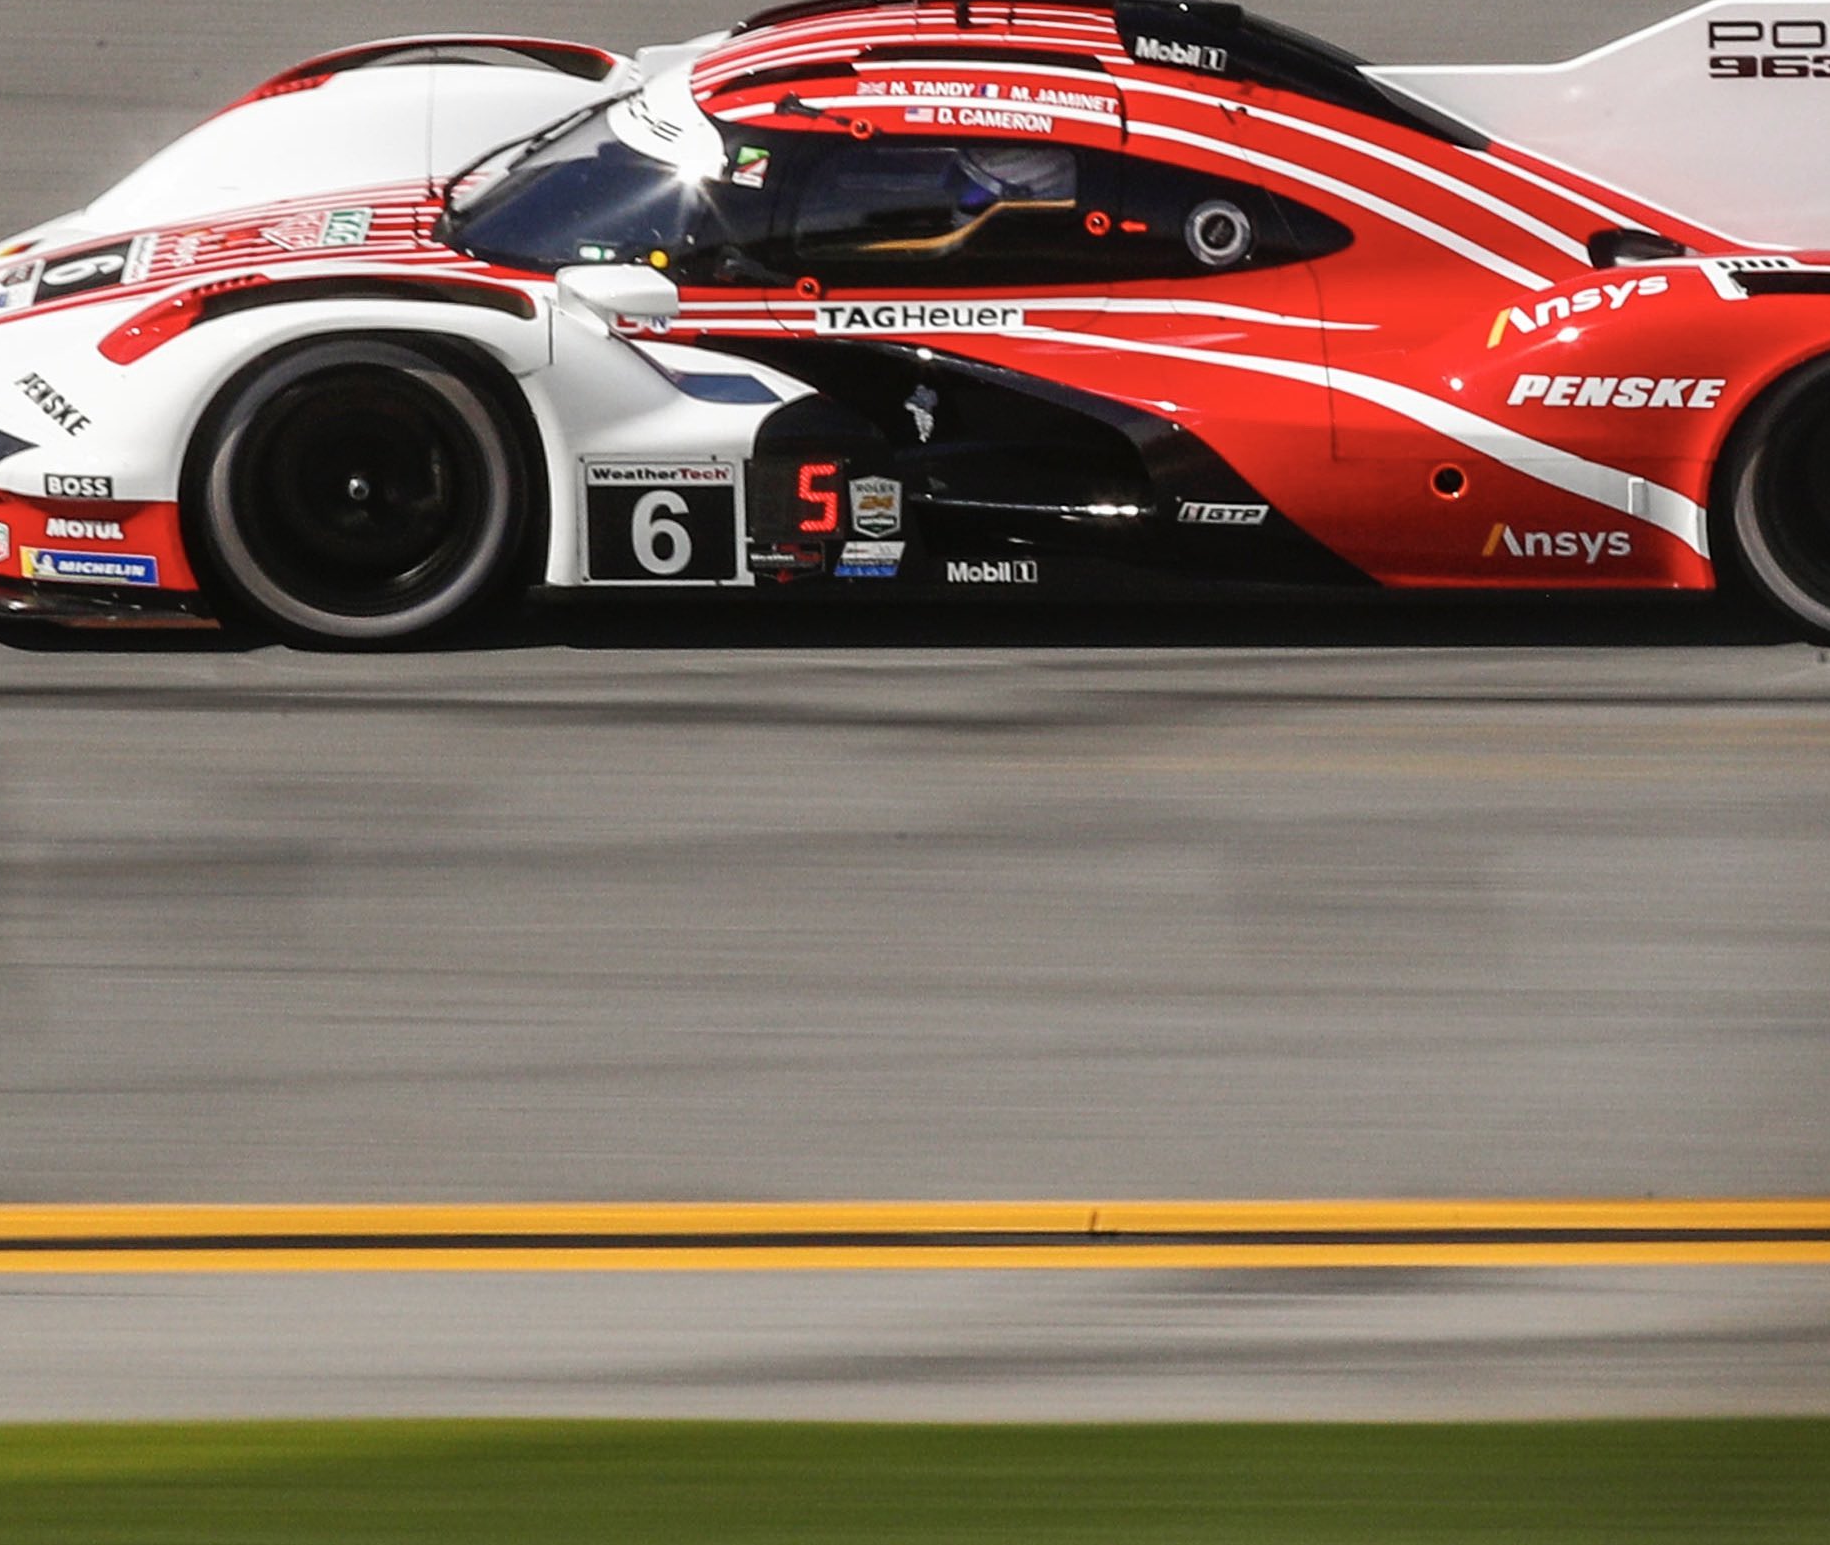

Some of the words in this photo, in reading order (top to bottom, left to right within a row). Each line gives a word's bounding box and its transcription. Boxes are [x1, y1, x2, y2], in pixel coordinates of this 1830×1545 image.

[1136, 37, 1202, 67] Mobil
[889, 82, 908, 96] N.
[912, 82, 976, 97] TANDY
[1010, 86, 1032, 102] M.
[1034, 90, 1118, 113] JAMINET
[937, 110, 956, 125] D.
[959, 111, 1053, 133] CAMERON
[42, 254, 125, 286] 6
[1486, 275, 1669, 349] Ansys
[14, 371, 93, 437] PENSKE
[1507, 374, 1726, 408] PENSKE
[47, 476, 110, 496] BOSS
[592, 467, 729, 480] WeatherTech
[798, 463, 838, 531] 5
[46, 518, 124, 540] MOTUL
[1206, 508, 1262, 522] GTP
[632, 490, 692, 575] 6
[1482, 523, 1631, 564] Ansys
[58, 560, 146, 577] MICHELIN
[946, 561, 1011, 582] Mobil
